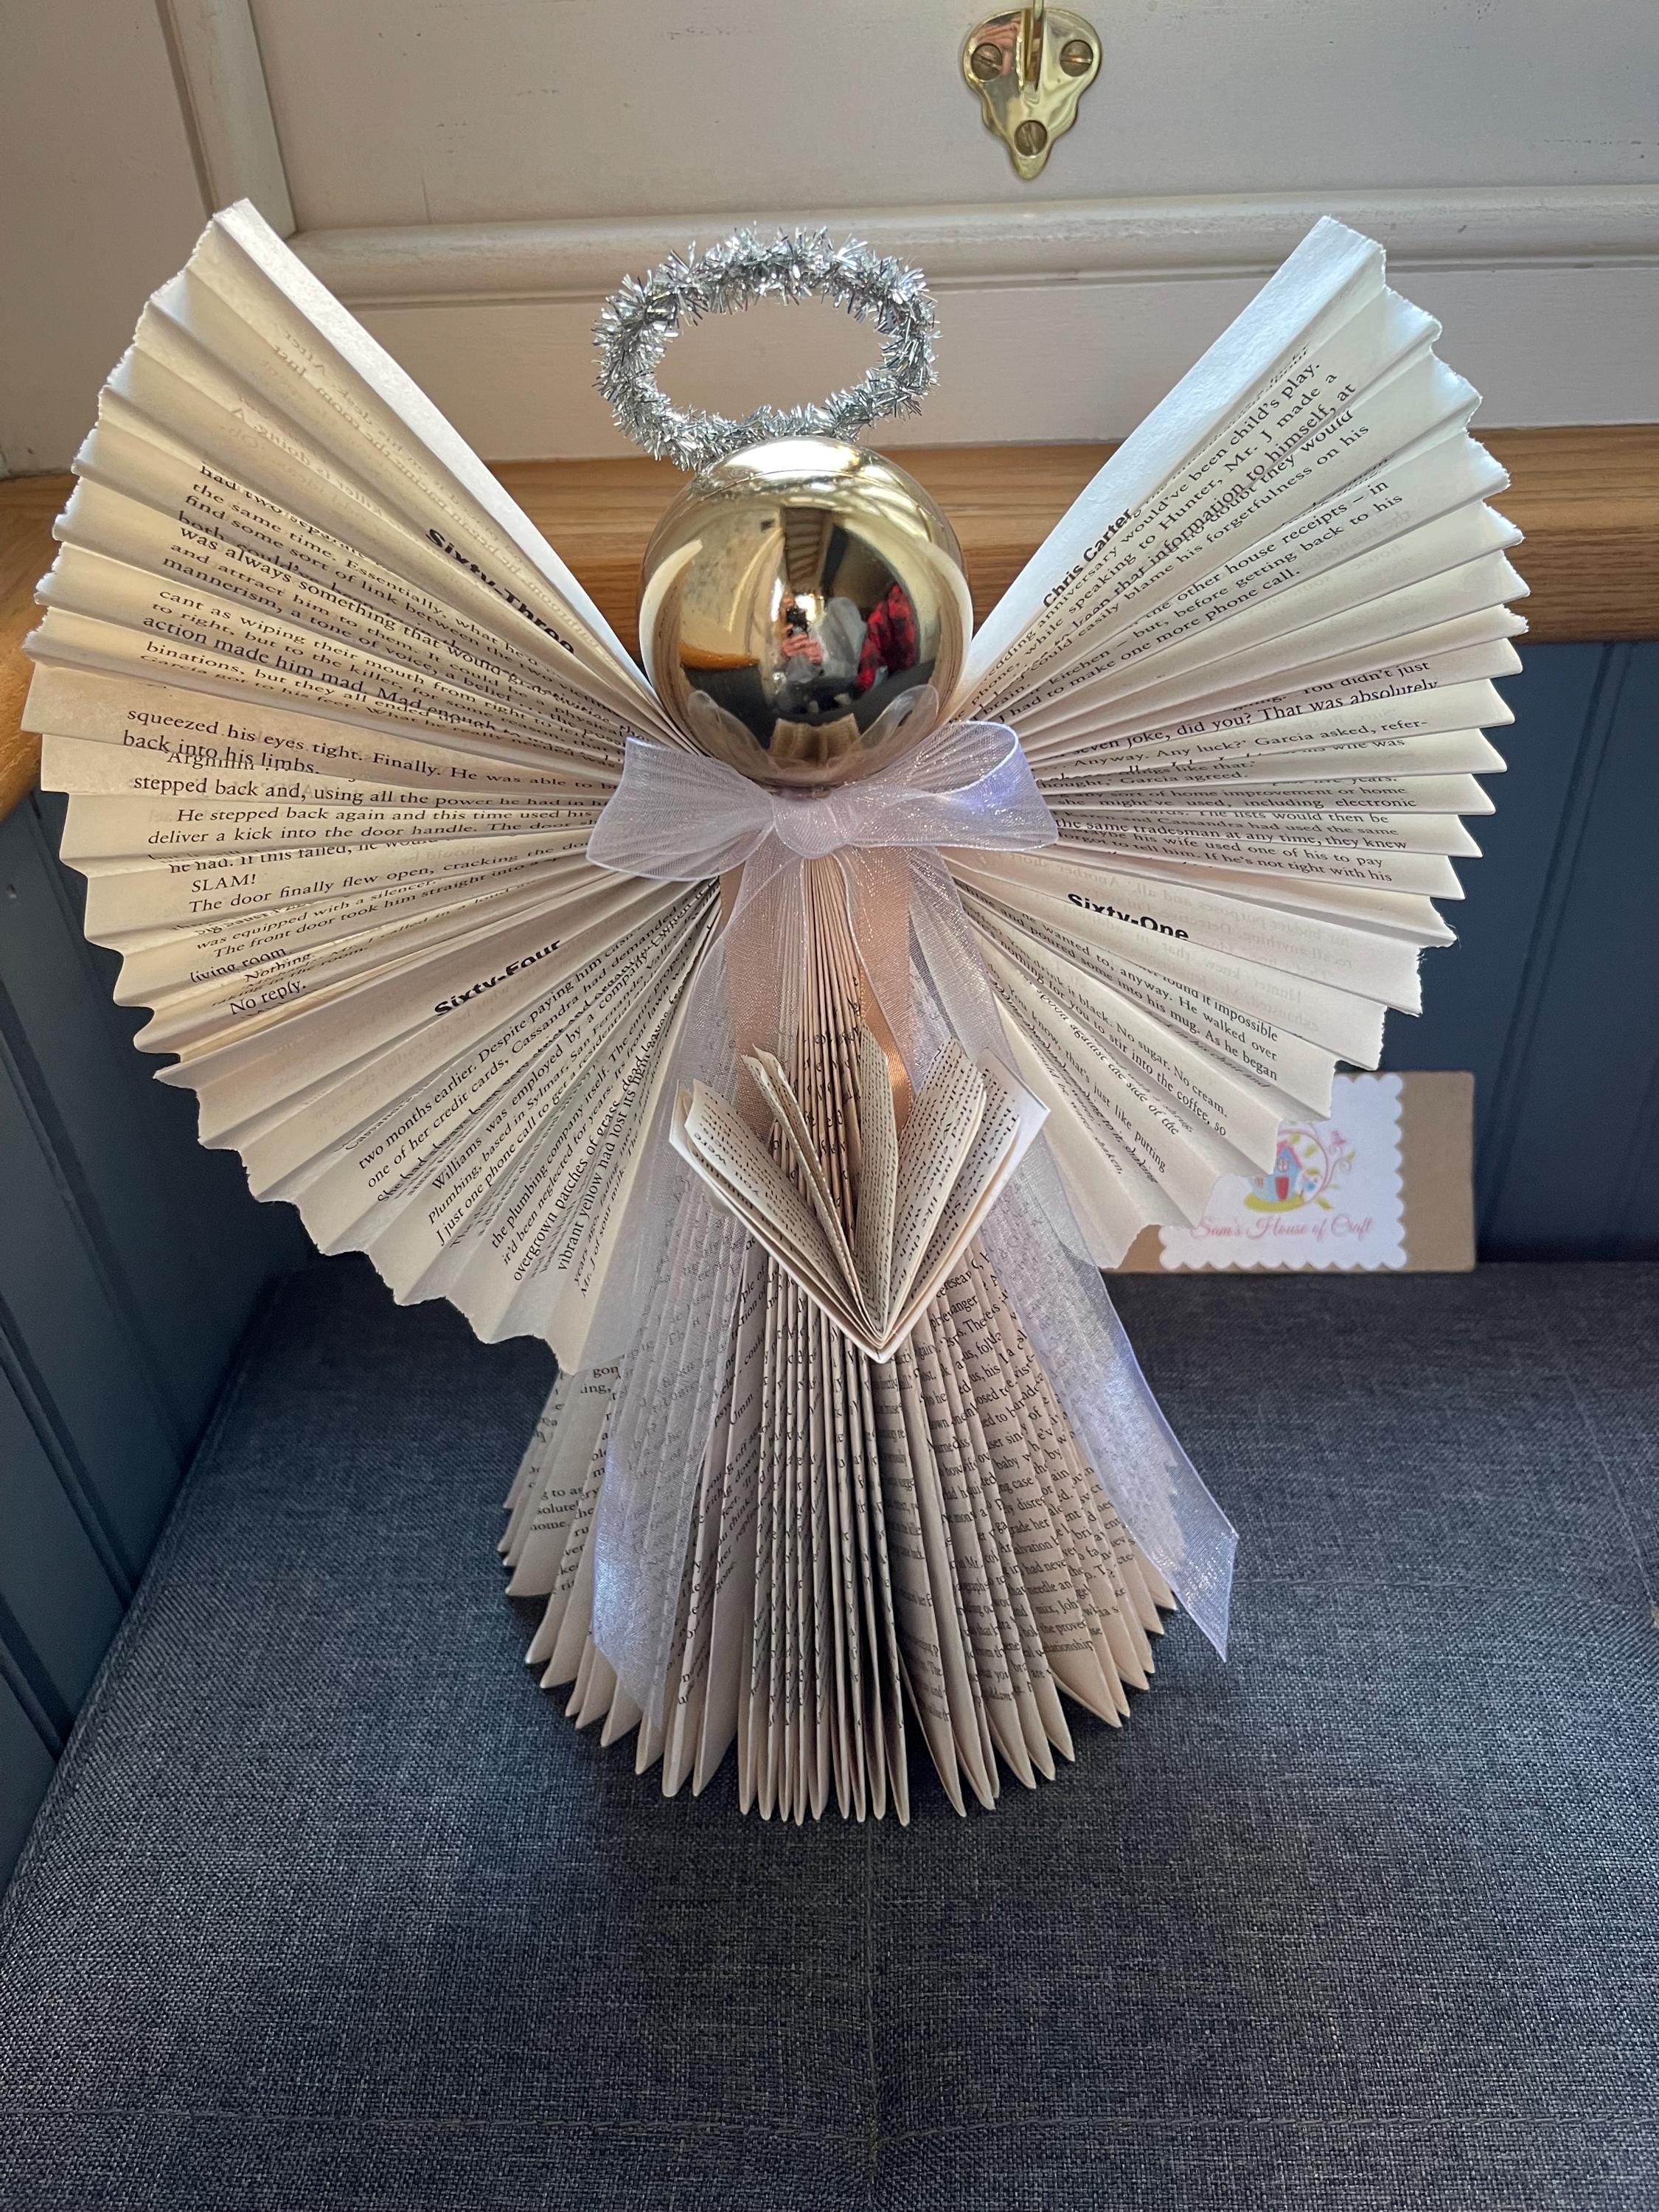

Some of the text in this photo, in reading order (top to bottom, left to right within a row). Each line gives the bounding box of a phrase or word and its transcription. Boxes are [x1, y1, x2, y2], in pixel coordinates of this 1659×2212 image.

[1121, 483, 1189, 543] would've
[1189, 450, 1228, 481] been
[1229, 398, 1280, 446] child's
[1281, 362, 1321, 400] play.
[1266, 384, 1357, 462] himself, at
[1068, 553, 1137, 615] speaking
[1138, 532, 1156, 548] to
[1158, 477, 1224, 530] Hunter,
[1225, 445, 1259, 473] Mr.
[1262, 430, 1273, 445] J
[1277, 385, 1322, 429] made
[1326, 372, 1338, 385] a
[1206, 424, 1370, 545] forgetfulness on his
[185, 495, 397, 605] find some sort of link
[193, 484, 336, 562] the same time.
[1043, 507, 1135, 608] Chris Carter
[1173, 493, 1401, 621] before getting back to his
[1224, 480, 1388, 577] house receipts in
[162, 557, 283, 614] mannerism,
[180, 527, 397, 631] was always something
[1155, 568, 1301, 647] more phone call.
[143, 616, 313, 678] action made him
[159, 591, 358, 660] cant as wiping their
[1397, 661, 1430, 679] just
[127, 709, 441, 776] squeezed his eyes tight. Finally.
[1126, 695, 1345, 751] joke, did you? That was
[1197, 719, 1428, 755] luck?' Garcia asked, refer-
[133, 776, 491, 808] stepped back and, using all the power
[176, 807, 512, 825] He stepped back again and this time
[1329, 813, 1388, 824] then be
[1335, 797, 1418, 808] electronic
[148, 823, 478, 844] deliver a kick into the door handle.
[1247, 832, 1407, 851] any time, they knew
[1282, 849, 1383, 869] of his to pay
[189, 868, 434, 914] The door finally flew open,
[191, 874, 257, 893] SLAM!
[1222, 854, 1393, 883] he's not tight with his
[230, 979, 307, 1015] No reply.
[1120, 968, 1279, 1063] anyway. He walked over
[1202, 994, 1279, 1043] it impossible
[1115, 1022, 1229, 1119] No sugar. No cream.
[1170, 1012, 1279, 1082] mug. As he began
[358, 1065, 478, 1171] two months earlier.
[367, 1058, 509, 1190] one of her credit cards,
[431, 1136, 483, 1191] Williams
[485, 1109, 509, 1133] was
[512, 1048, 564, 1105] employed
[1131, 1051, 1228, 1137] into the coffee, so
[1113, 1104, 1166, 1173] like putting
[513, 1158, 588, 1281] overgrown patches
[557, 1169, 602, 1270] vibrant yellow
[1246, 1216, 1309, 1241] House
[1312, 1222, 1326, 1242] of
[1330, 1213, 1376, 1242] Craft
